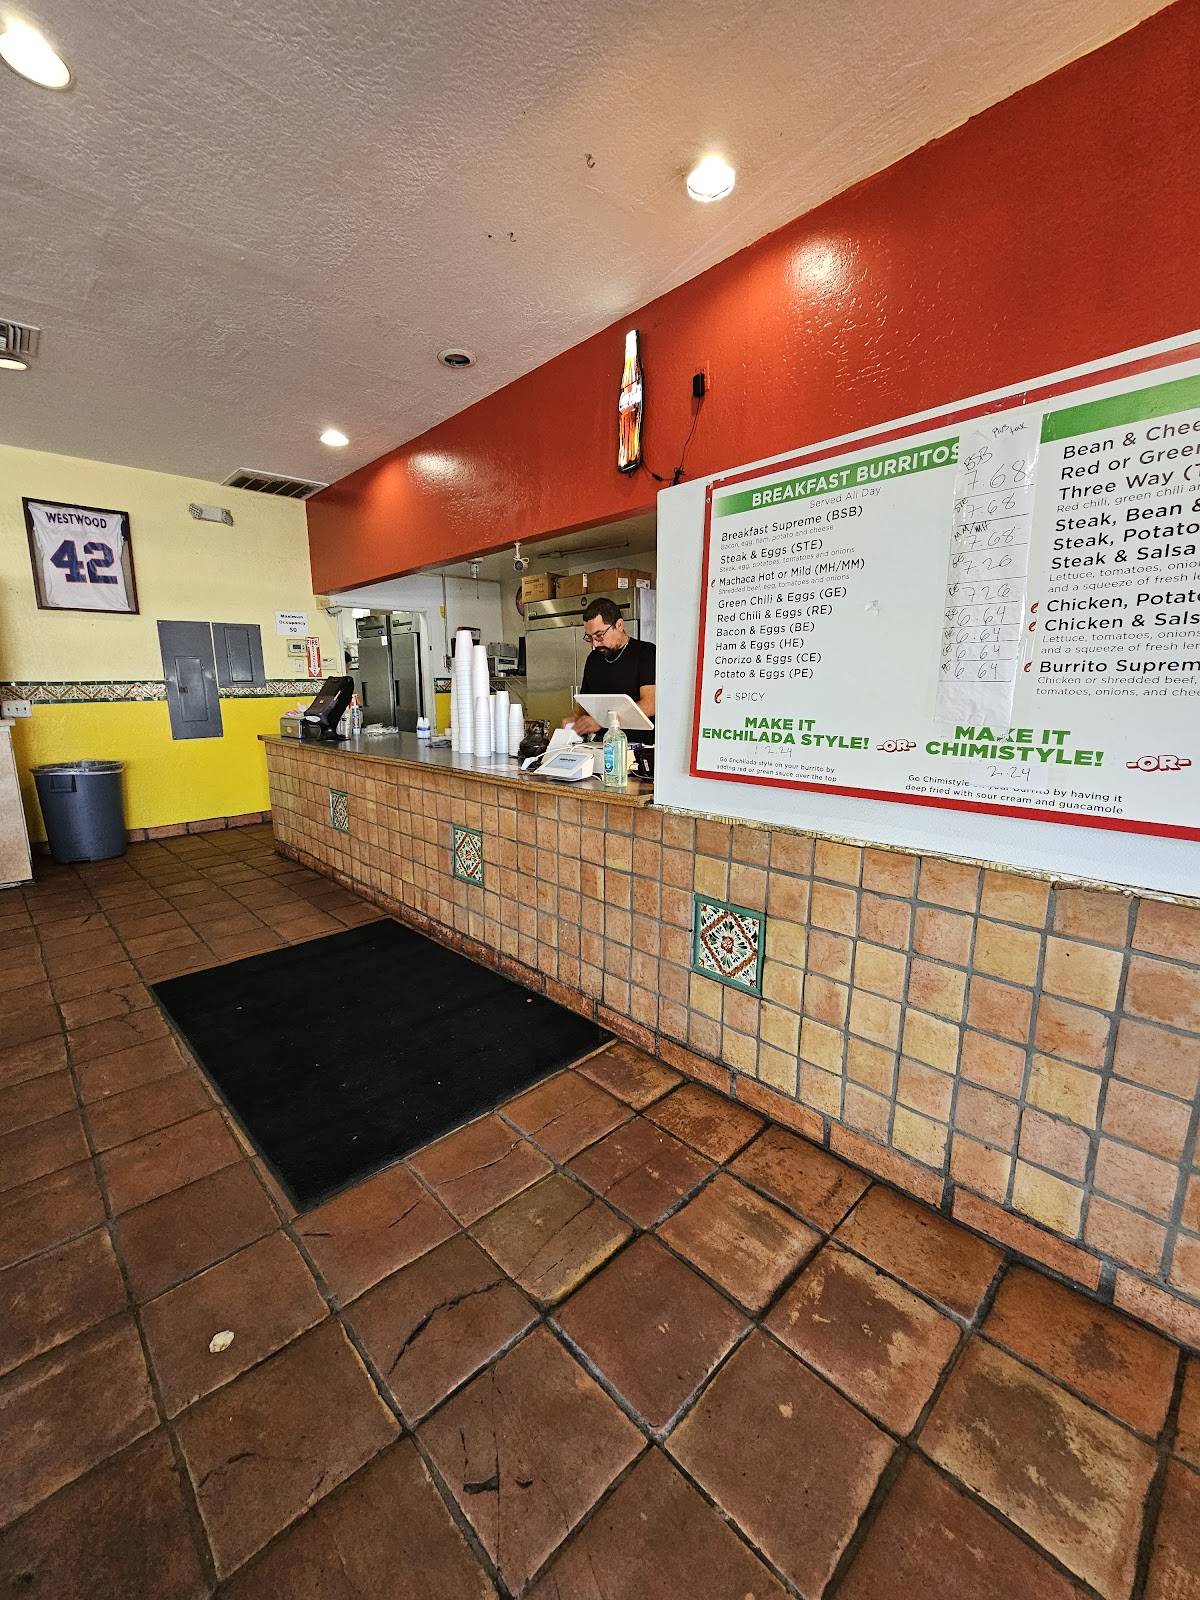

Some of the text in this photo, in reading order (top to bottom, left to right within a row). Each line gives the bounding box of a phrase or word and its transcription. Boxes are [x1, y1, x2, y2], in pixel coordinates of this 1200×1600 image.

[1064, 439, 1114, 460] Bean
[1122, 432, 1137, 448] &
[751, 442, 960, 507] BREAKFAST BURRITOS
[1061, 457, 1131, 480] Red or
[1060, 481, 1116, 500] Three
[1126, 471, 1174, 488] Way
[809, 486, 882, 509] Served All Day
[1056, 503, 1078, 512] Red
[1083, 498, 1110, 508] chili,
[1115, 492, 1152, 505] green
[1156, 484, 1184, 497] chili
[45, 511, 107, 529] WESTWOOD
[721, 505, 864, 542] Breakfast Supreme (BSB)
[1055, 512, 1117, 532] Steak,
[1126, 504, 1182, 522] Bean
[809, 525, 834, 534] cheese
[1053, 522, 1200, 551] Steak, Potato
[720, 538, 824, 565] Steak & Eggs (STE)
[816, 550, 829, 558] and
[830, 546, 856, 556] onions
[1051, 544, 1196, 570] Steak & Salsa
[49, 539, 118, 585] 42
[719, 558, 866, 587] Machaca Hot or Mild (MH/MM)
[778, 578, 809, 588] tomatoes
[826, 574, 850, 582] onions
[1050, 564, 1162, 582] Lettuce, tomatoes,
[1048, 582, 1068, 592] and
[1083, 578, 1133, 591] squeeze
[1137, 576, 1150, 586] of
[1155, 573, 1188, 584] fresh
[718, 586, 848, 609] Green Chili & Eggs (GE)
[1047, 597, 1128, 612] Chicken,
[718, 604, 833, 622] Red Chili & Eggs (RE)
[716, 622, 816, 637] Bacon & Eggs (BE)
[1044, 616, 1123, 632] Chicken
[1132, 614, 1145, 627] &
[716, 638, 804, 651] Ham & Eggs (HE)
[1042, 632, 1153, 643] Lettuce, tomatoes,
[1041, 646, 1061, 654] and
[1076, 645, 1124, 655] squeeze
[1128, 643, 1142, 652] of
[1146, 642, 1178, 651] fresh
[715, 652, 822, 666] Chorizo & Eggs (CE)
[1040, 660, 1108, 673] Burrito
[714, 668, 814, 680] Potato & Eggs (PE)
[1037, 676, 1081, 684] Chicken
[1101, 676, 1160, 684] shredded
[1164, 676, 1198, 685] beef,
[735, 692, 766, 702] SPICY
[1036, 688, 1168, 697] tomatoes, onions, and
[744, 716, 816, 732] MAKE IT
[702, 728, 870, 750] ENCHILADA STYLE!
[876, 738, 917, 753] -OR-
[1042, 730, 1072, 746] IT
[925, 740, 1104, 767] CHIMISTYLE!
[728, 756, 757, 766] Enchilada
[758, 760, 773, 768] style
[784, 762, 800, 770] your
[800, 764, 824, 773] burrito
[826, 766, 835, 774] by
[1126, 754, 1192, 773] -OR-
[756, 768, 774, 776] green
[776, 770, 797, 778] sauce
[908, 774, 970, 788] Go Chimistyle
[905, 784, 927, 794] deep
[929, 785, 950, 795] fried
[953, 788, 973, 798] with
[976, 792, 997, 800] sour
[1000, 794, 1032, 804] cream
[1035, 796, 1056, 807] and
[1058, 800, 1124, 815] guacamole
[1054, 788, 1067, 800] by
[1070, 789, 1110, 803] having
[1114, 794, 1123, 803] it
